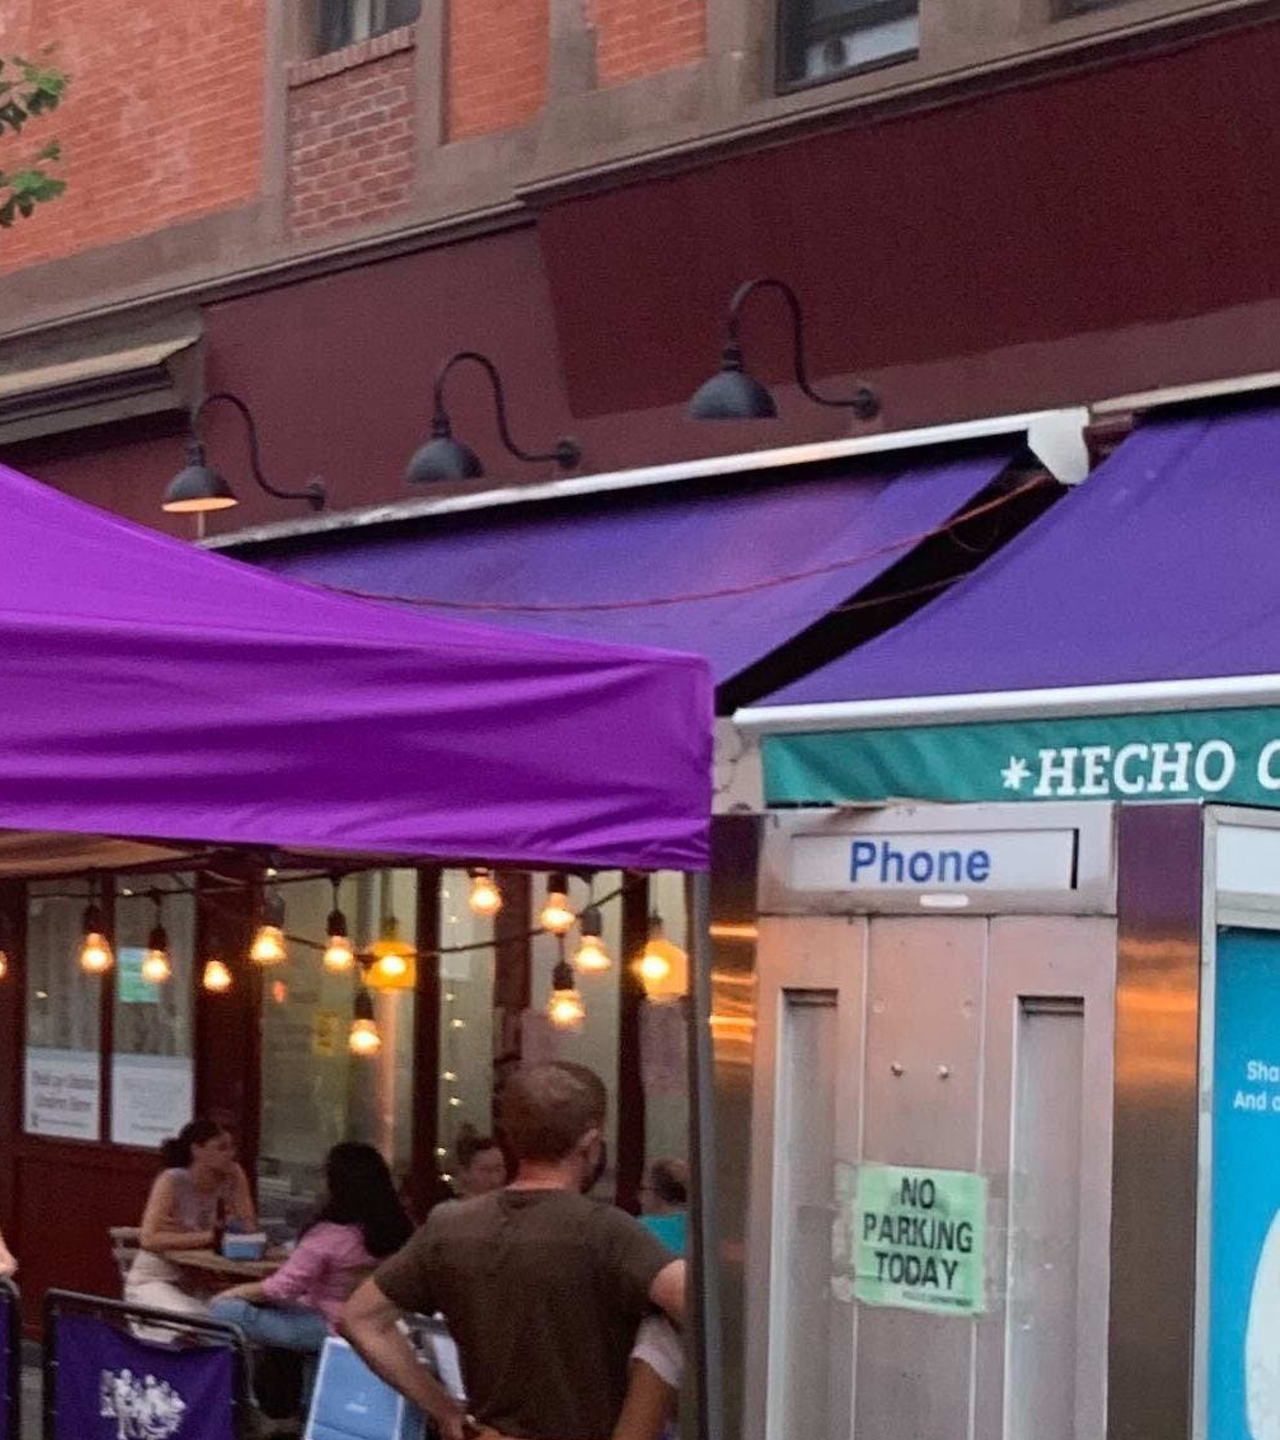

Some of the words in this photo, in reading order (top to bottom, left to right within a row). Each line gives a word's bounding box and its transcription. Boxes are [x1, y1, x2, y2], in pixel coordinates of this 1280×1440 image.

[1033, 739, 1236, 796] HECHO
[850, 841, 990, 883] Phone
[1234, 1090, 1267, 1111] And
[900, 1177, 937, 1209] NO
[862, 1212, 974, 1253] PARKING
[874, 1250, 959, 1291] TODAY
